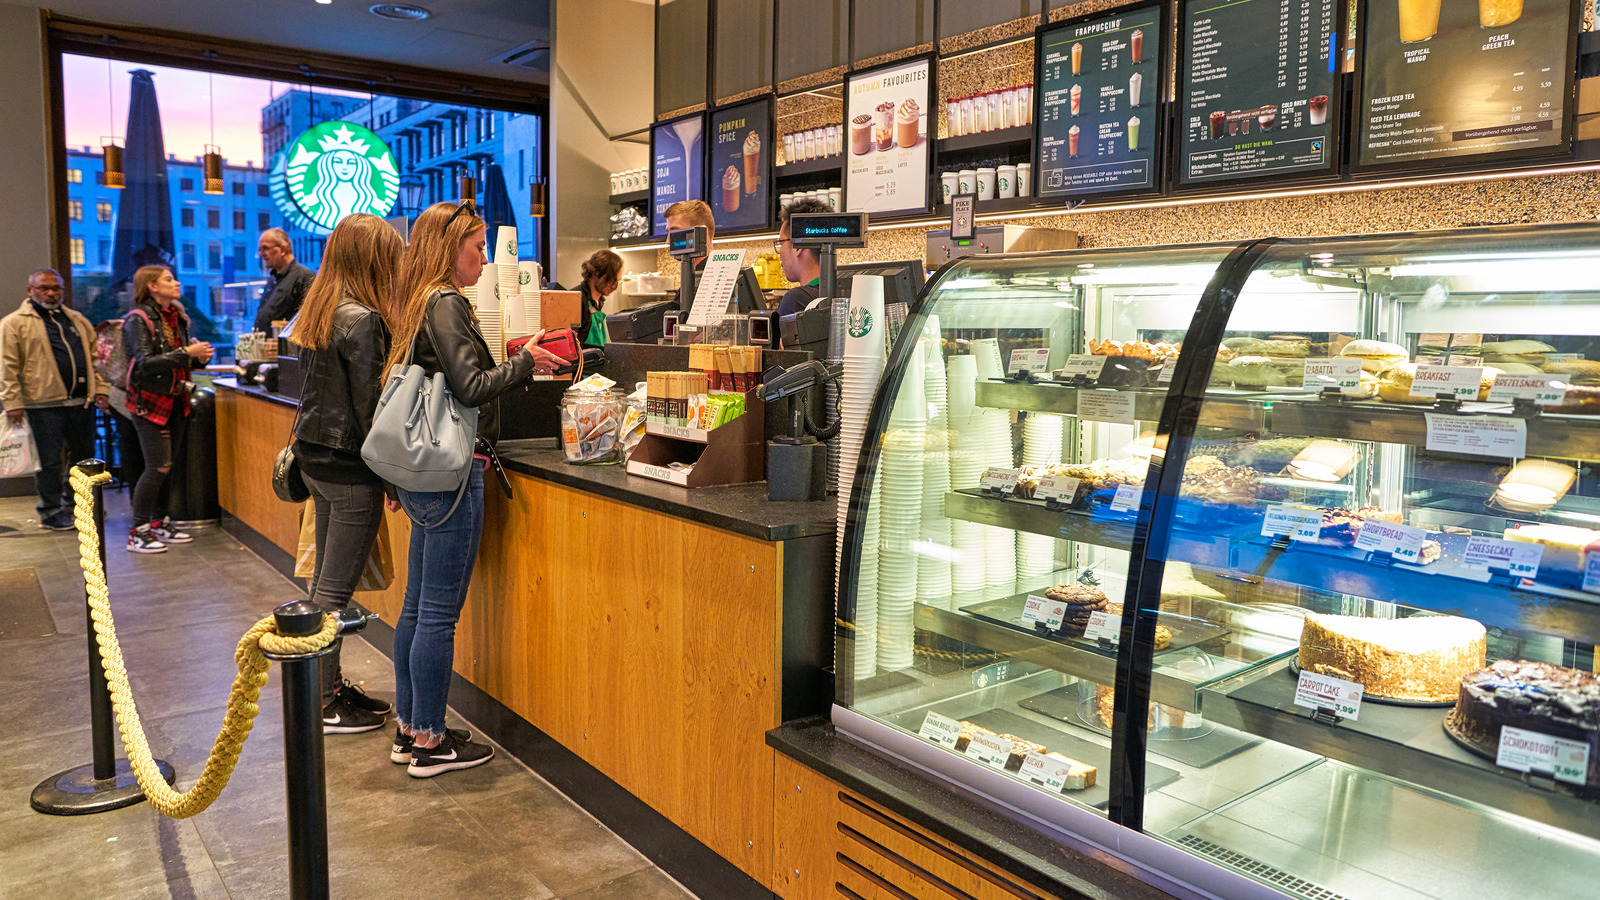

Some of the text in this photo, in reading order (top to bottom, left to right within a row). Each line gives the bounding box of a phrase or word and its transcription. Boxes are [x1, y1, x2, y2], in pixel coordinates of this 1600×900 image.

[1489, 34, 1509, 43] PEACH
[1482, 41, 1502, 50] GREEN
[1404, 48, 1430, 58] TROPICAL
[1407, 55, 1426, 63] MANGO
[854, 69, 926, 95] AUTUMN FAVOURITES
[1394, 111, 1420, 120] LEMONADE
[719, 118, 746, 132] PUMPKIN
[719, 132, 736, 143] SPICE
[1465, 129, 1499, 137] Vorübergehend
[657, 167, 669, 178] SOJA
[657, 184, 676, 196] MANDEL
[1306, 366, 1333, 375] CIABATTA
[1415, 371, 1452, 382] BREAKFAST
[1494, 379, 1545, 388] BREZELSNACK
[663, 426, 690, 438] SNACKS
[644, 466, 671, 480] SNACKS
[1362, 523, 1404, 541] SHORTBREAD
[1468, 543, 1515, 557] CHEESECAKE
[1026, 600, 1041, 611] COOKIE
[1090, 617, 1106, 627] COOKIE
[1300, 678, 1340, 697] CARROT CAKE
[1502, 736, 1559, 757] SCHOKOTORTE
[1026, 756, 1045, 768] KUCHEN
